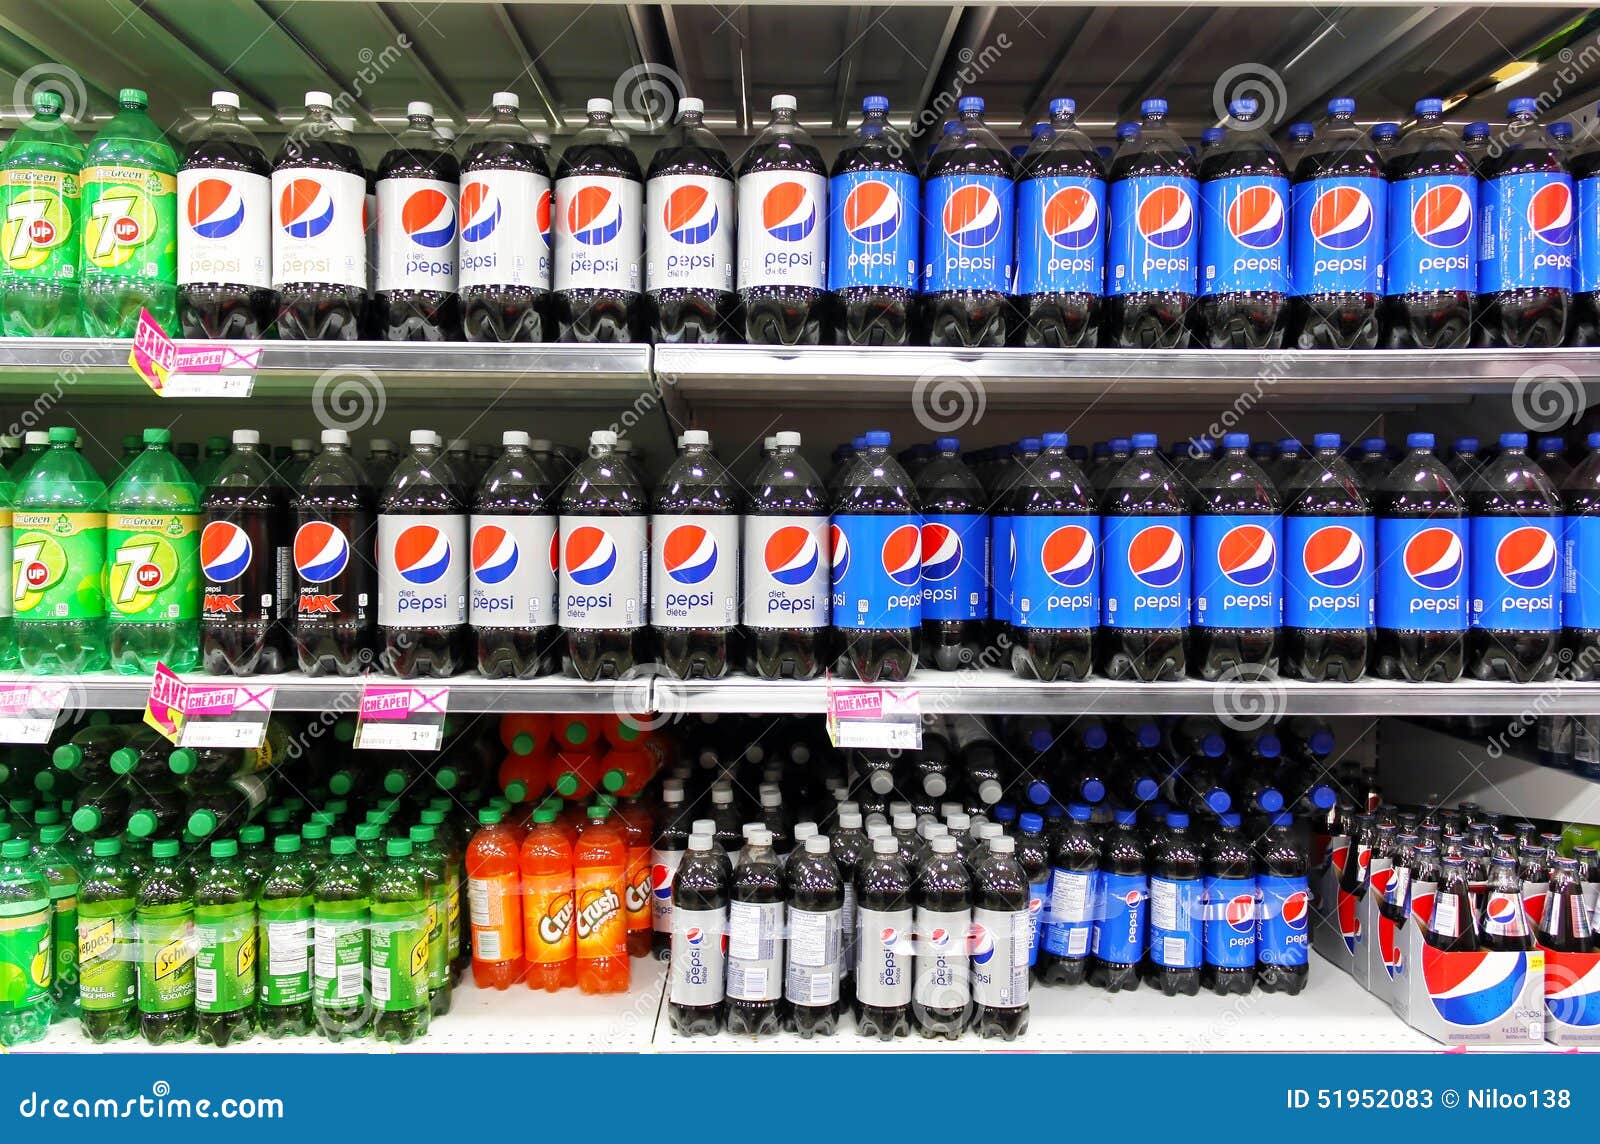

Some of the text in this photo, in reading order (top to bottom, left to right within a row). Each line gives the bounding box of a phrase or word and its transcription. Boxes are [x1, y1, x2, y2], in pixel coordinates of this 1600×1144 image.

[190, 258, 240, 275] pepsi
[283, 257, 330, 275] pepsi
[571, 260, 618, 275] pepsi
[667, 252, 715, 270] pepsi
[765, 251, 812, 267] pepsi
[848, 251, 896, 271] pepsi
[946, 255, 995, 273] pepsi
[1047, 257, 1094, 274] pepsi
[1143, 257, 1188, 274] pepsi
[1234, 256, 1281, 274] pepsi
[1314, 256, 1366, 276] pepsi
[1419, 254, 1469, 274] pepsi
[406, 260, 453, 277] pepsi
[176, 354, 221, 367] CHEAPER
[203, 594, 244, 612] MAX
[398, 590, 416, 598] diet
[567, 593, 612, 610] pepsi
[666, 592, 713, 609] pepsi
[768, 590, 786, 598] diet
[887, 595, 921, 611] peps
[922, 587, 957, 603] epsi
[1048, 593, 1093, 611] pepsi
[1134, 593, 1181, 611] pepsi
[1224, 592, 1272, 610] pepsi
[1309, 594, 1360, 611] pepsi
[298, 594, 343, 613] MAX
[398, 595, 448, 613] pepsi
[473, 595, 514, 612] pepsi
[768, 596, 815, 613] pepsi
[1410, 595, 1459, 613] pepsi
[1502, 595, 1553, 613] pepsi
[153, 673, 187, 711] SAVE
[189, 694, 233, 708] CHEAPER
[364, 696, 408, 711] CHEAPER
[837, 697, 880, 710] CHEAPER
[577, 888, 621, 940] Crush
[1128, 909, 1138, 943] pepsi
[691, 948, 703, 985] pepsi
[884, 948, 896, 986] pepsi
